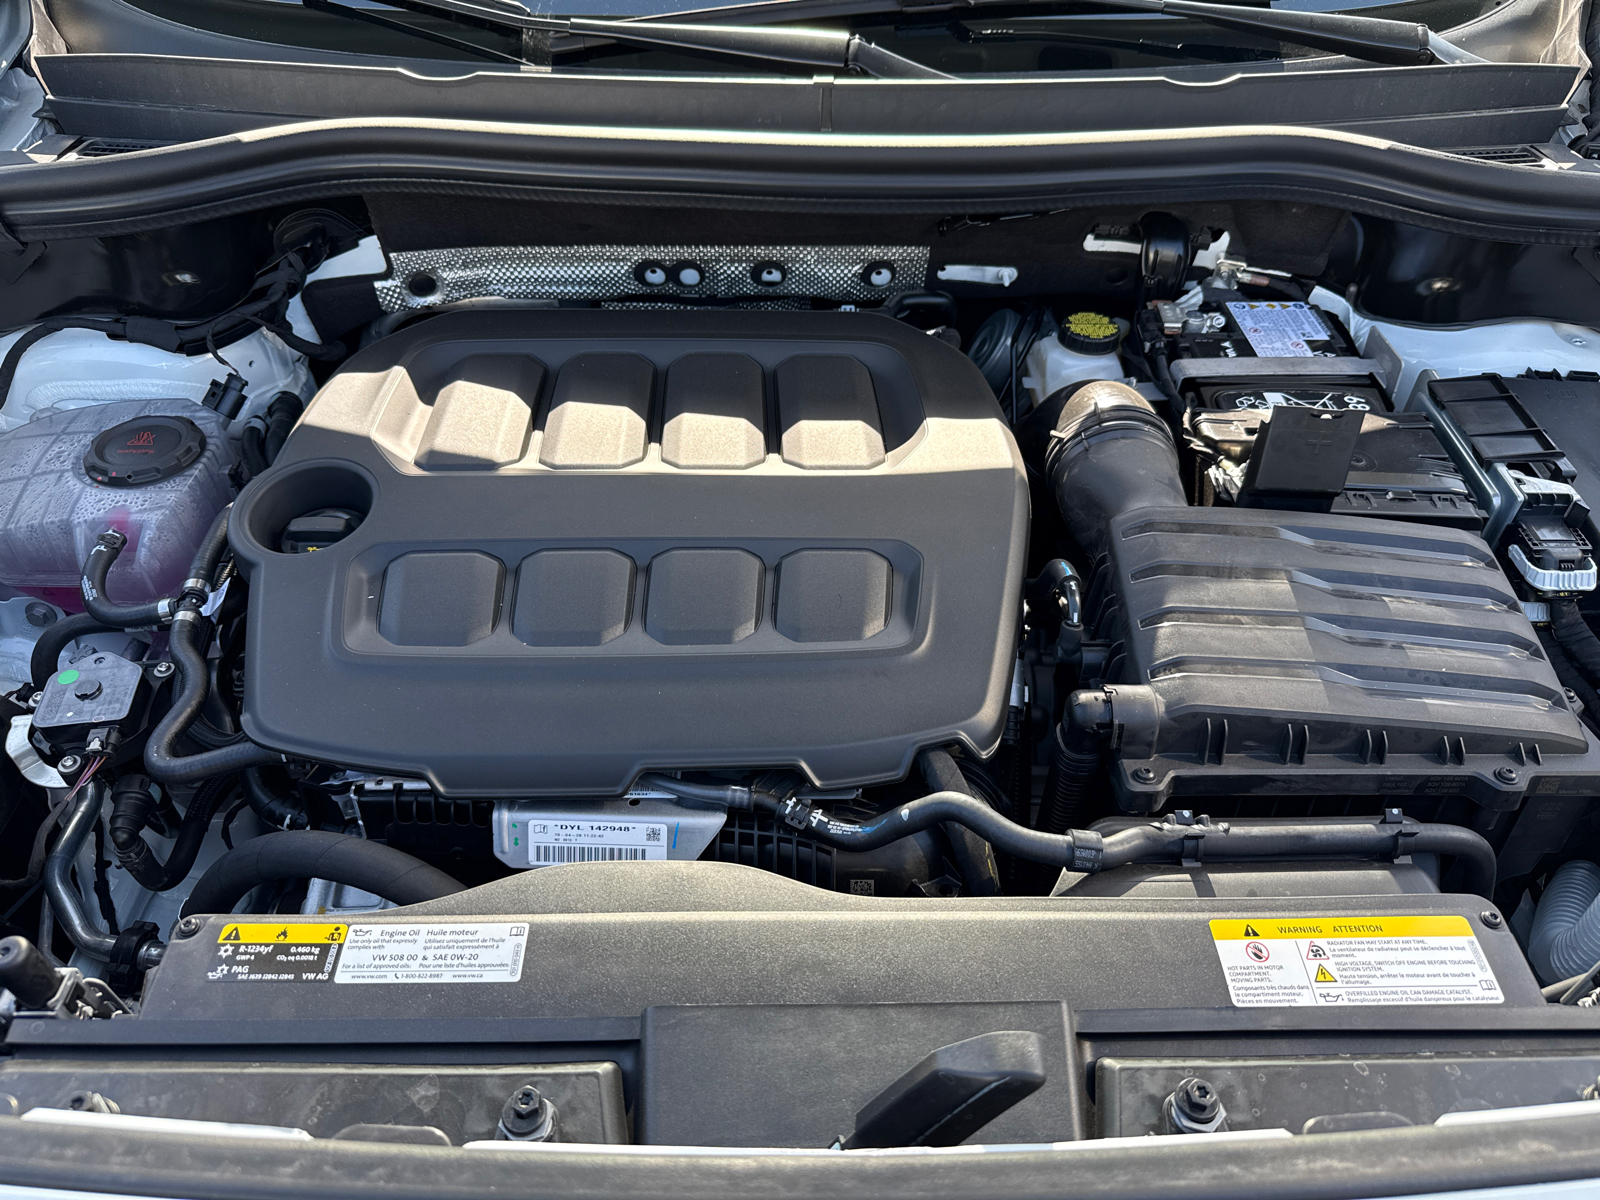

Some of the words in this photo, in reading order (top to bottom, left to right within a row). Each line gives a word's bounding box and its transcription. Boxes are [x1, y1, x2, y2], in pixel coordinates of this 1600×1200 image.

[1277, 925, 1323, 934] WARNING
[1332, 924, 1383, 933] ATTENTION
[380, 929, 407, 938] Engine
[239, 945, 274, 955] R-1234yf
[311, 946, 320, 954] kg
[406, 953, 418, 961] 00
[432, 953, 449, 961] SAE
[450, 953, 479, 961] 0W-20
[231, 965, 250, 973] PAG
